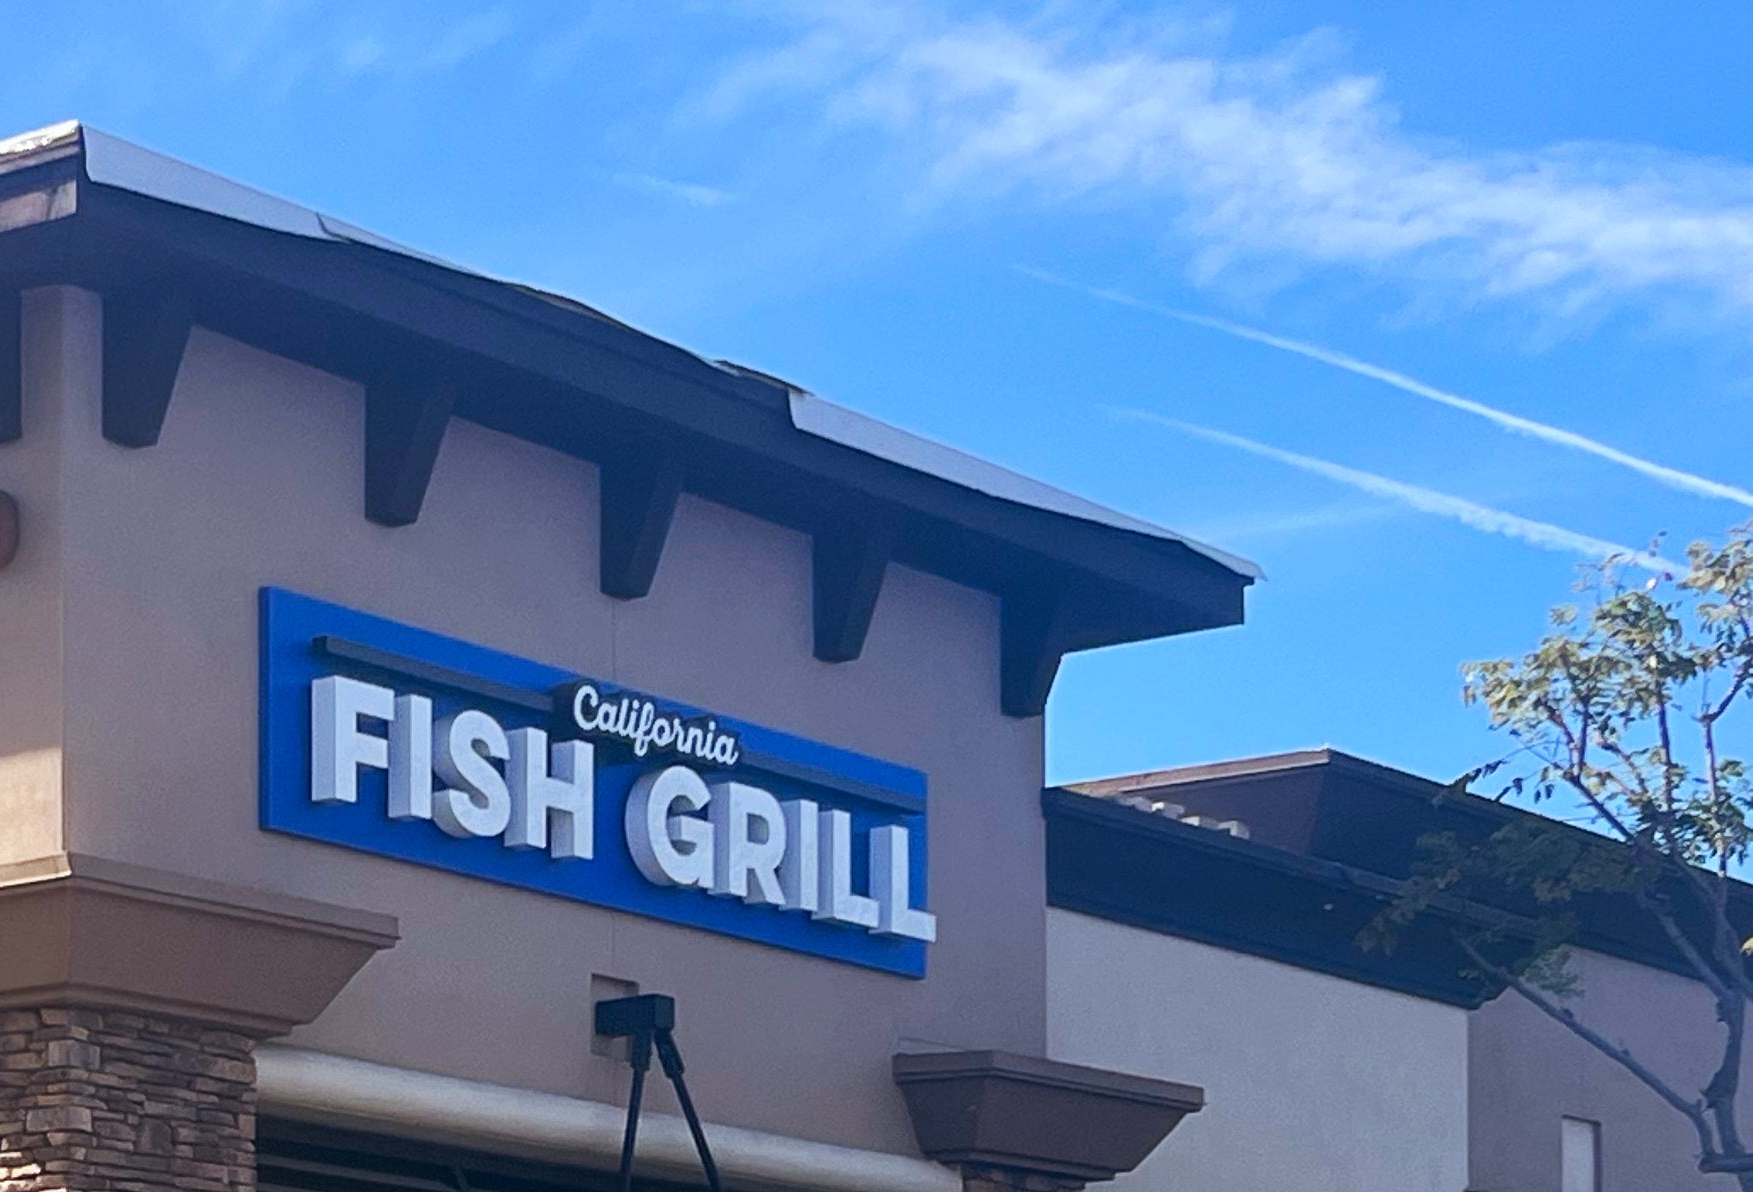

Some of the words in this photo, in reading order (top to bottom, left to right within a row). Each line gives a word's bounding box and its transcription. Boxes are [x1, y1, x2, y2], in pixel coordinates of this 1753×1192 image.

[310, 674, 595, 860] FISH
[625, 764, 937, 943] GRILL
[573, 683, 739, 767] California
